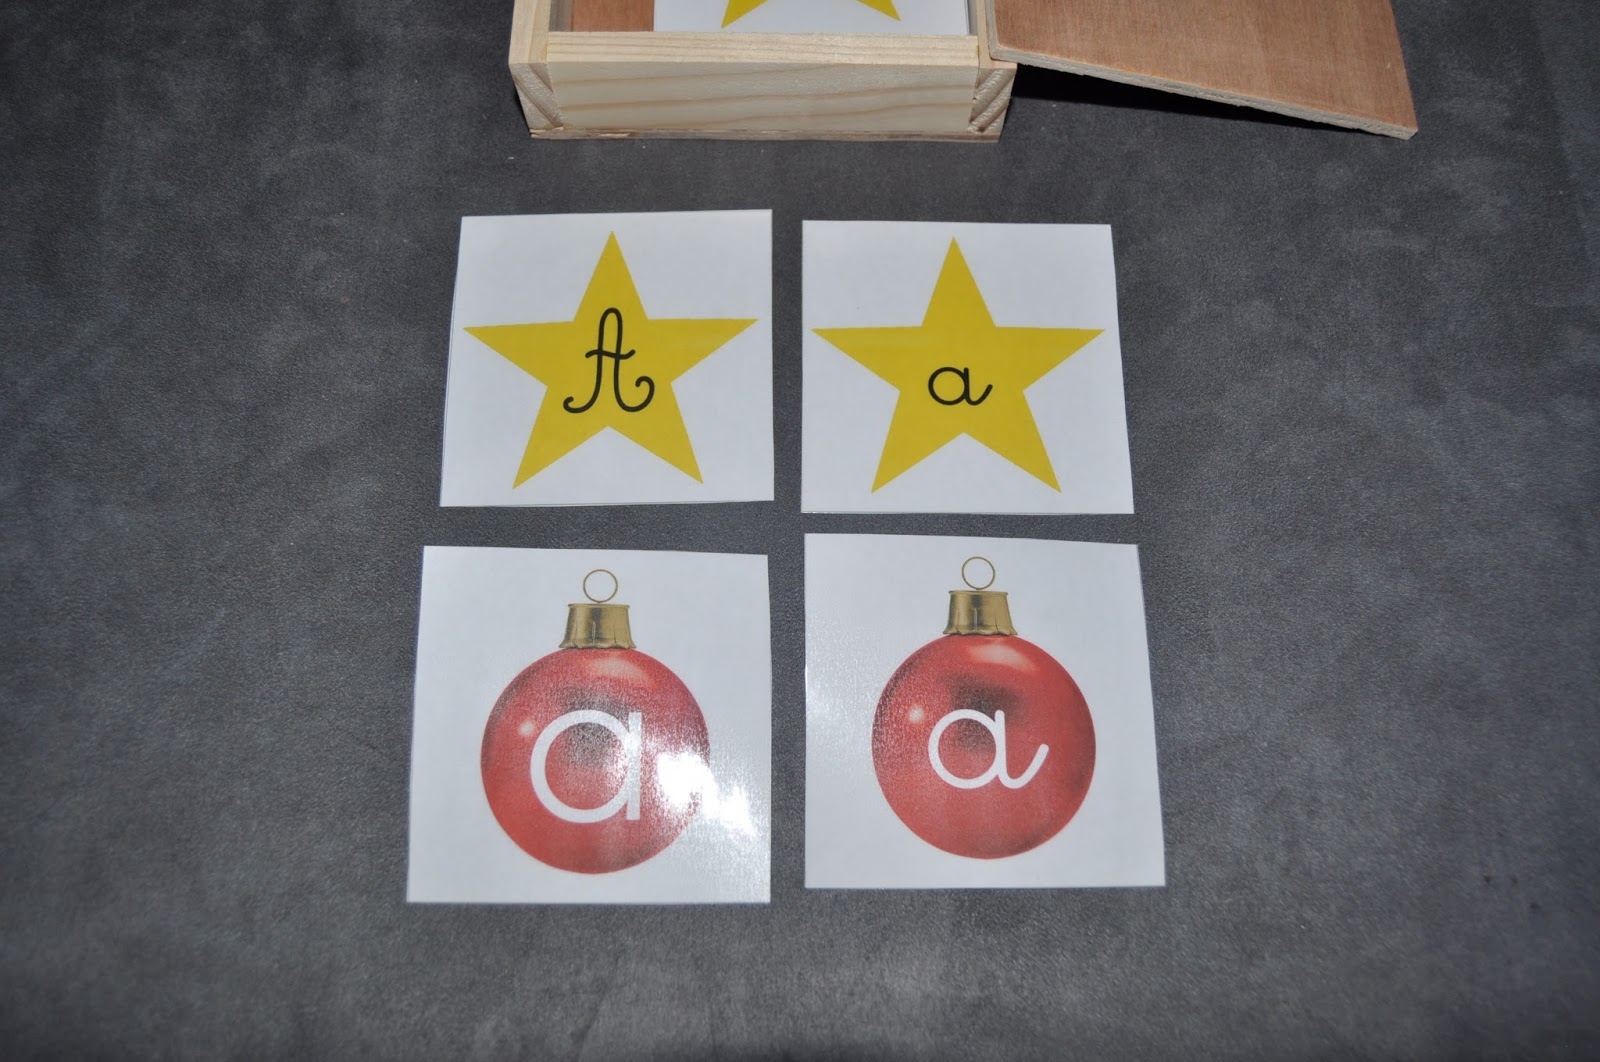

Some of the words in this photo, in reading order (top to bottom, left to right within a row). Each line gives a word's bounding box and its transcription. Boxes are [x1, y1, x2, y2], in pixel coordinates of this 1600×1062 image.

[563, 308, 655, 414] A
[928, 366, 993, 406] a
[529, 709, 642, 824] a
[928, 708, 1050, 790] a
